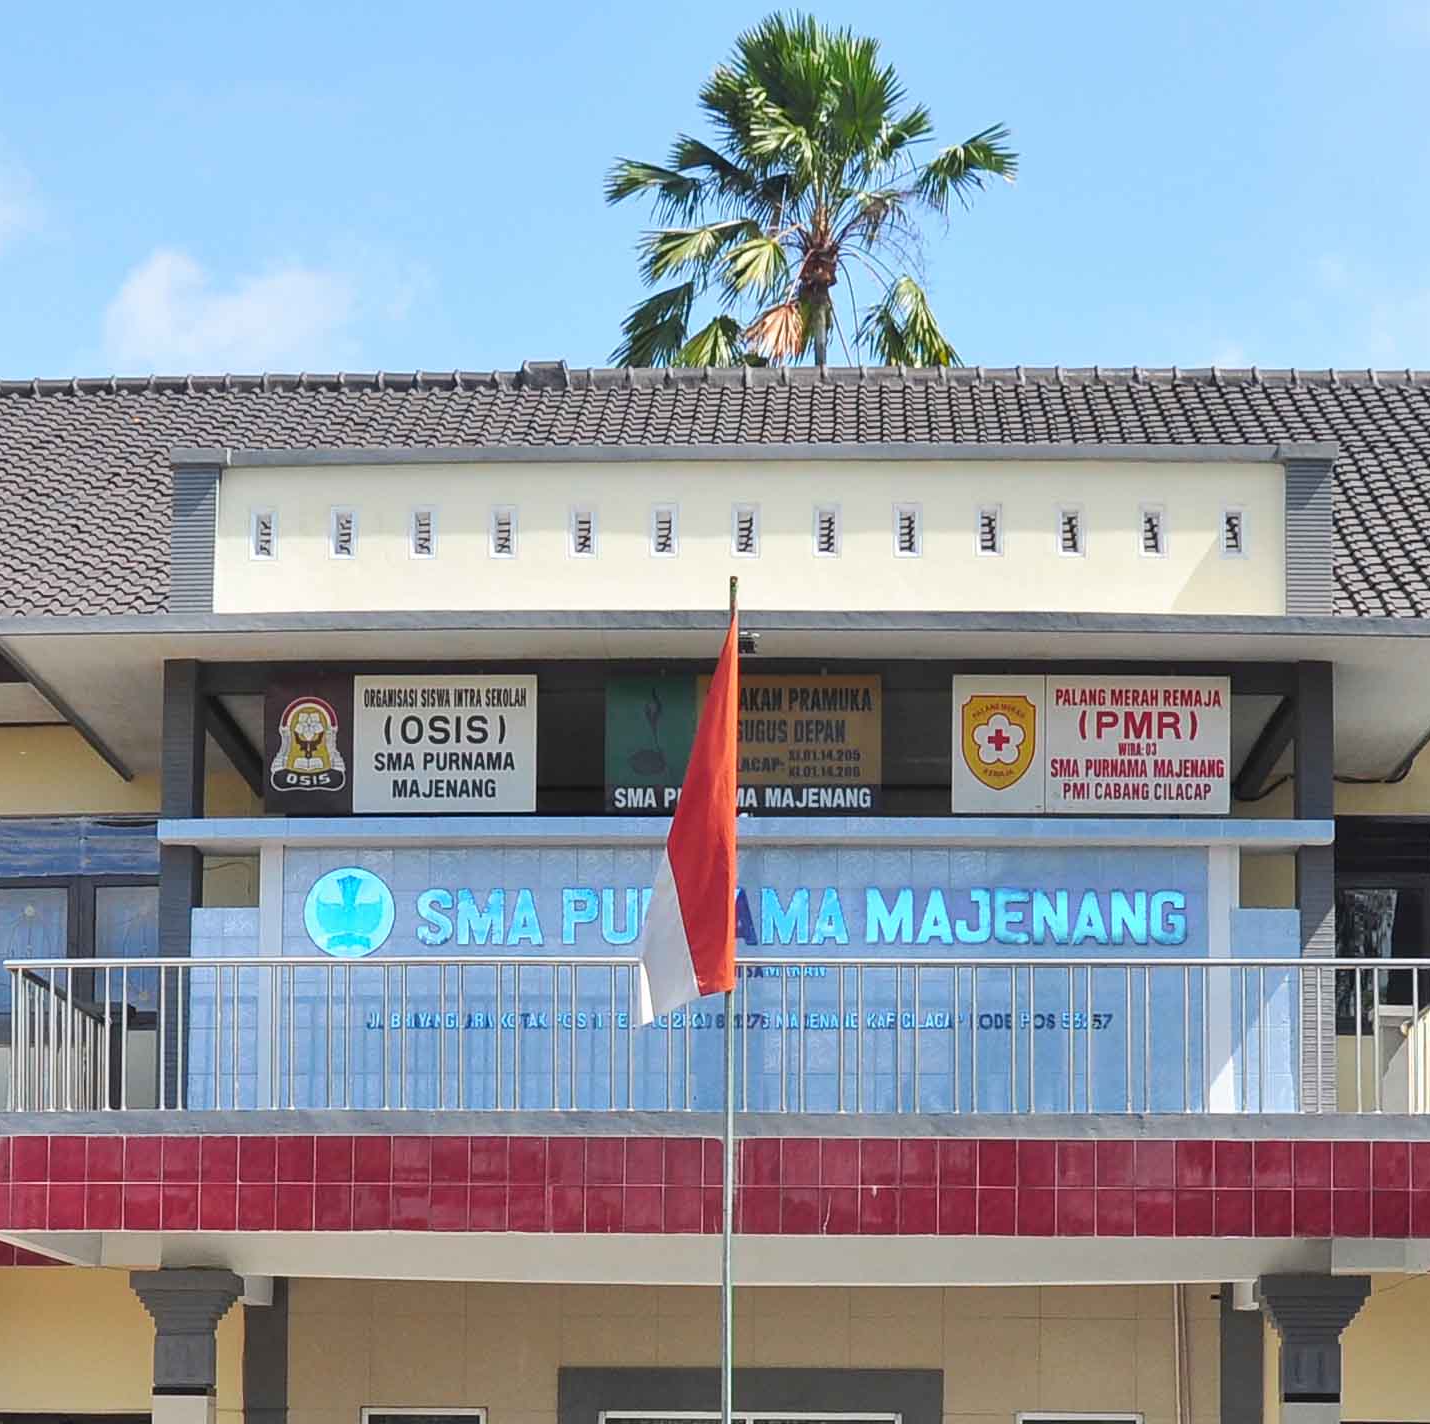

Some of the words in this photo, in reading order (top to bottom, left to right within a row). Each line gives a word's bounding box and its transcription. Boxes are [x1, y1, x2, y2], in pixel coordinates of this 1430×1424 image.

[364, 688, 417, 708] ORGANISASI
[421, 688, 450, 707] SISWA
[454, 688, 482, 707] INTRA
[486, 688, 526, 707] SEKOLAH
[788, 688, 872, 711] PRAMUKA
[1055, 689, 1106, 706] PALANG
[1110, 689, 1159, 706] MERAH
[1163, 689, 1222, 707] REMAJA
[794, 719, 847, 743] DEPAN
[374, 752, 415, 771] SMA
[423, 752, 515, 770] PURNAMA
[1050, 759, 1079, 778] SMA
[1085, 759, 1148, 778] PURNAMA
[1153, 759, 1224, 778] MAJENANG
[286, 773, 331, 785] OSIS
[393, 779, 496, 798] MAJENANG
[614, 787, 657, 808] SMA
[765, 787, 871, 808] MAJENANG
[1063, 783, 1090, 800] PMI
[1094, 783, 1150, 800] CABANG
[1154, 783, 1212, 800] CILACAP
[416, 888, 544, 945] SMA
[562, 888, 850, 945] PUAMA
[865, 887, 1188, 945] MAJENANG
[970, 1012, 1013, 1030] ODE
